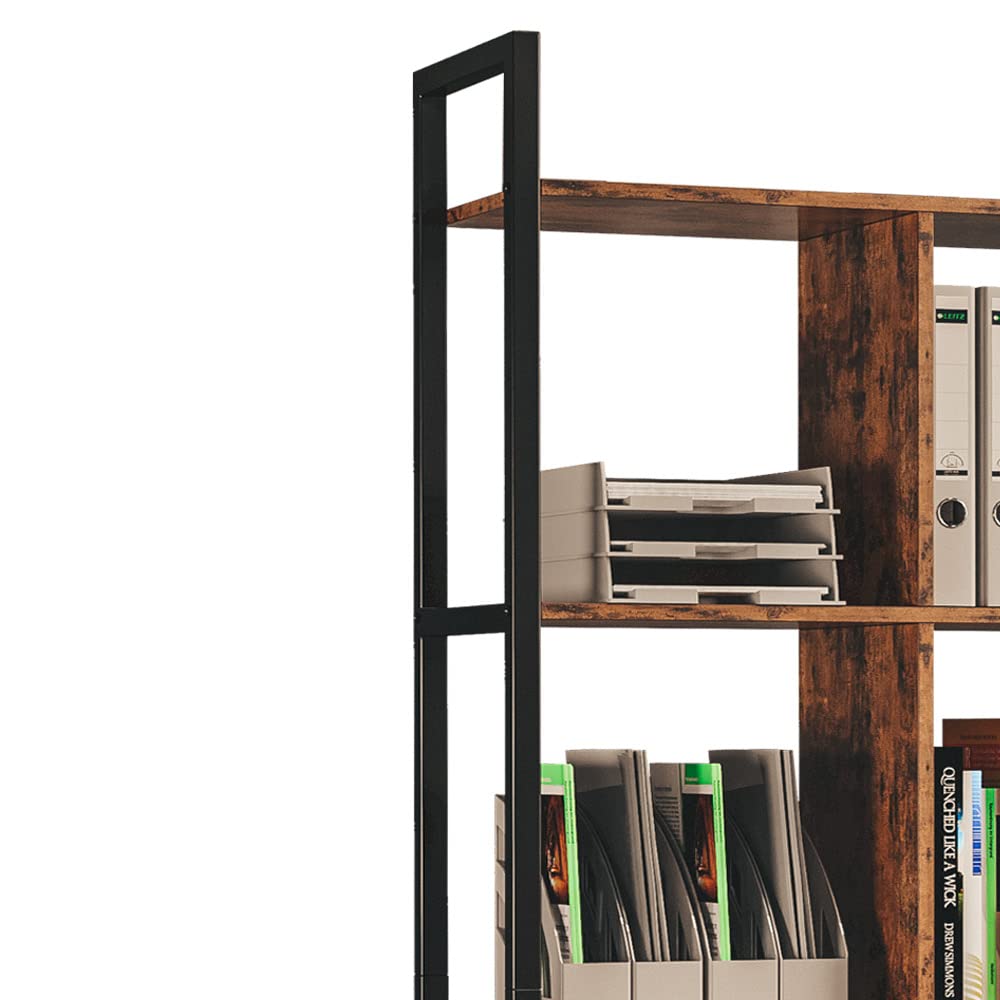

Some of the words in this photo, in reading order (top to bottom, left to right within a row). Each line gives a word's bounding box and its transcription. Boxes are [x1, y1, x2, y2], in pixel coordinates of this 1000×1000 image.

[940, 766, 956, 834] QUENCHED
[943, 835, 957, 860] LIKE
[943, 860, 957, 872] A
[943, 872, 957, 909] WICK
[943, 922, 956, 952] DREW
[943, 952, 956, 998] SIMMONS
